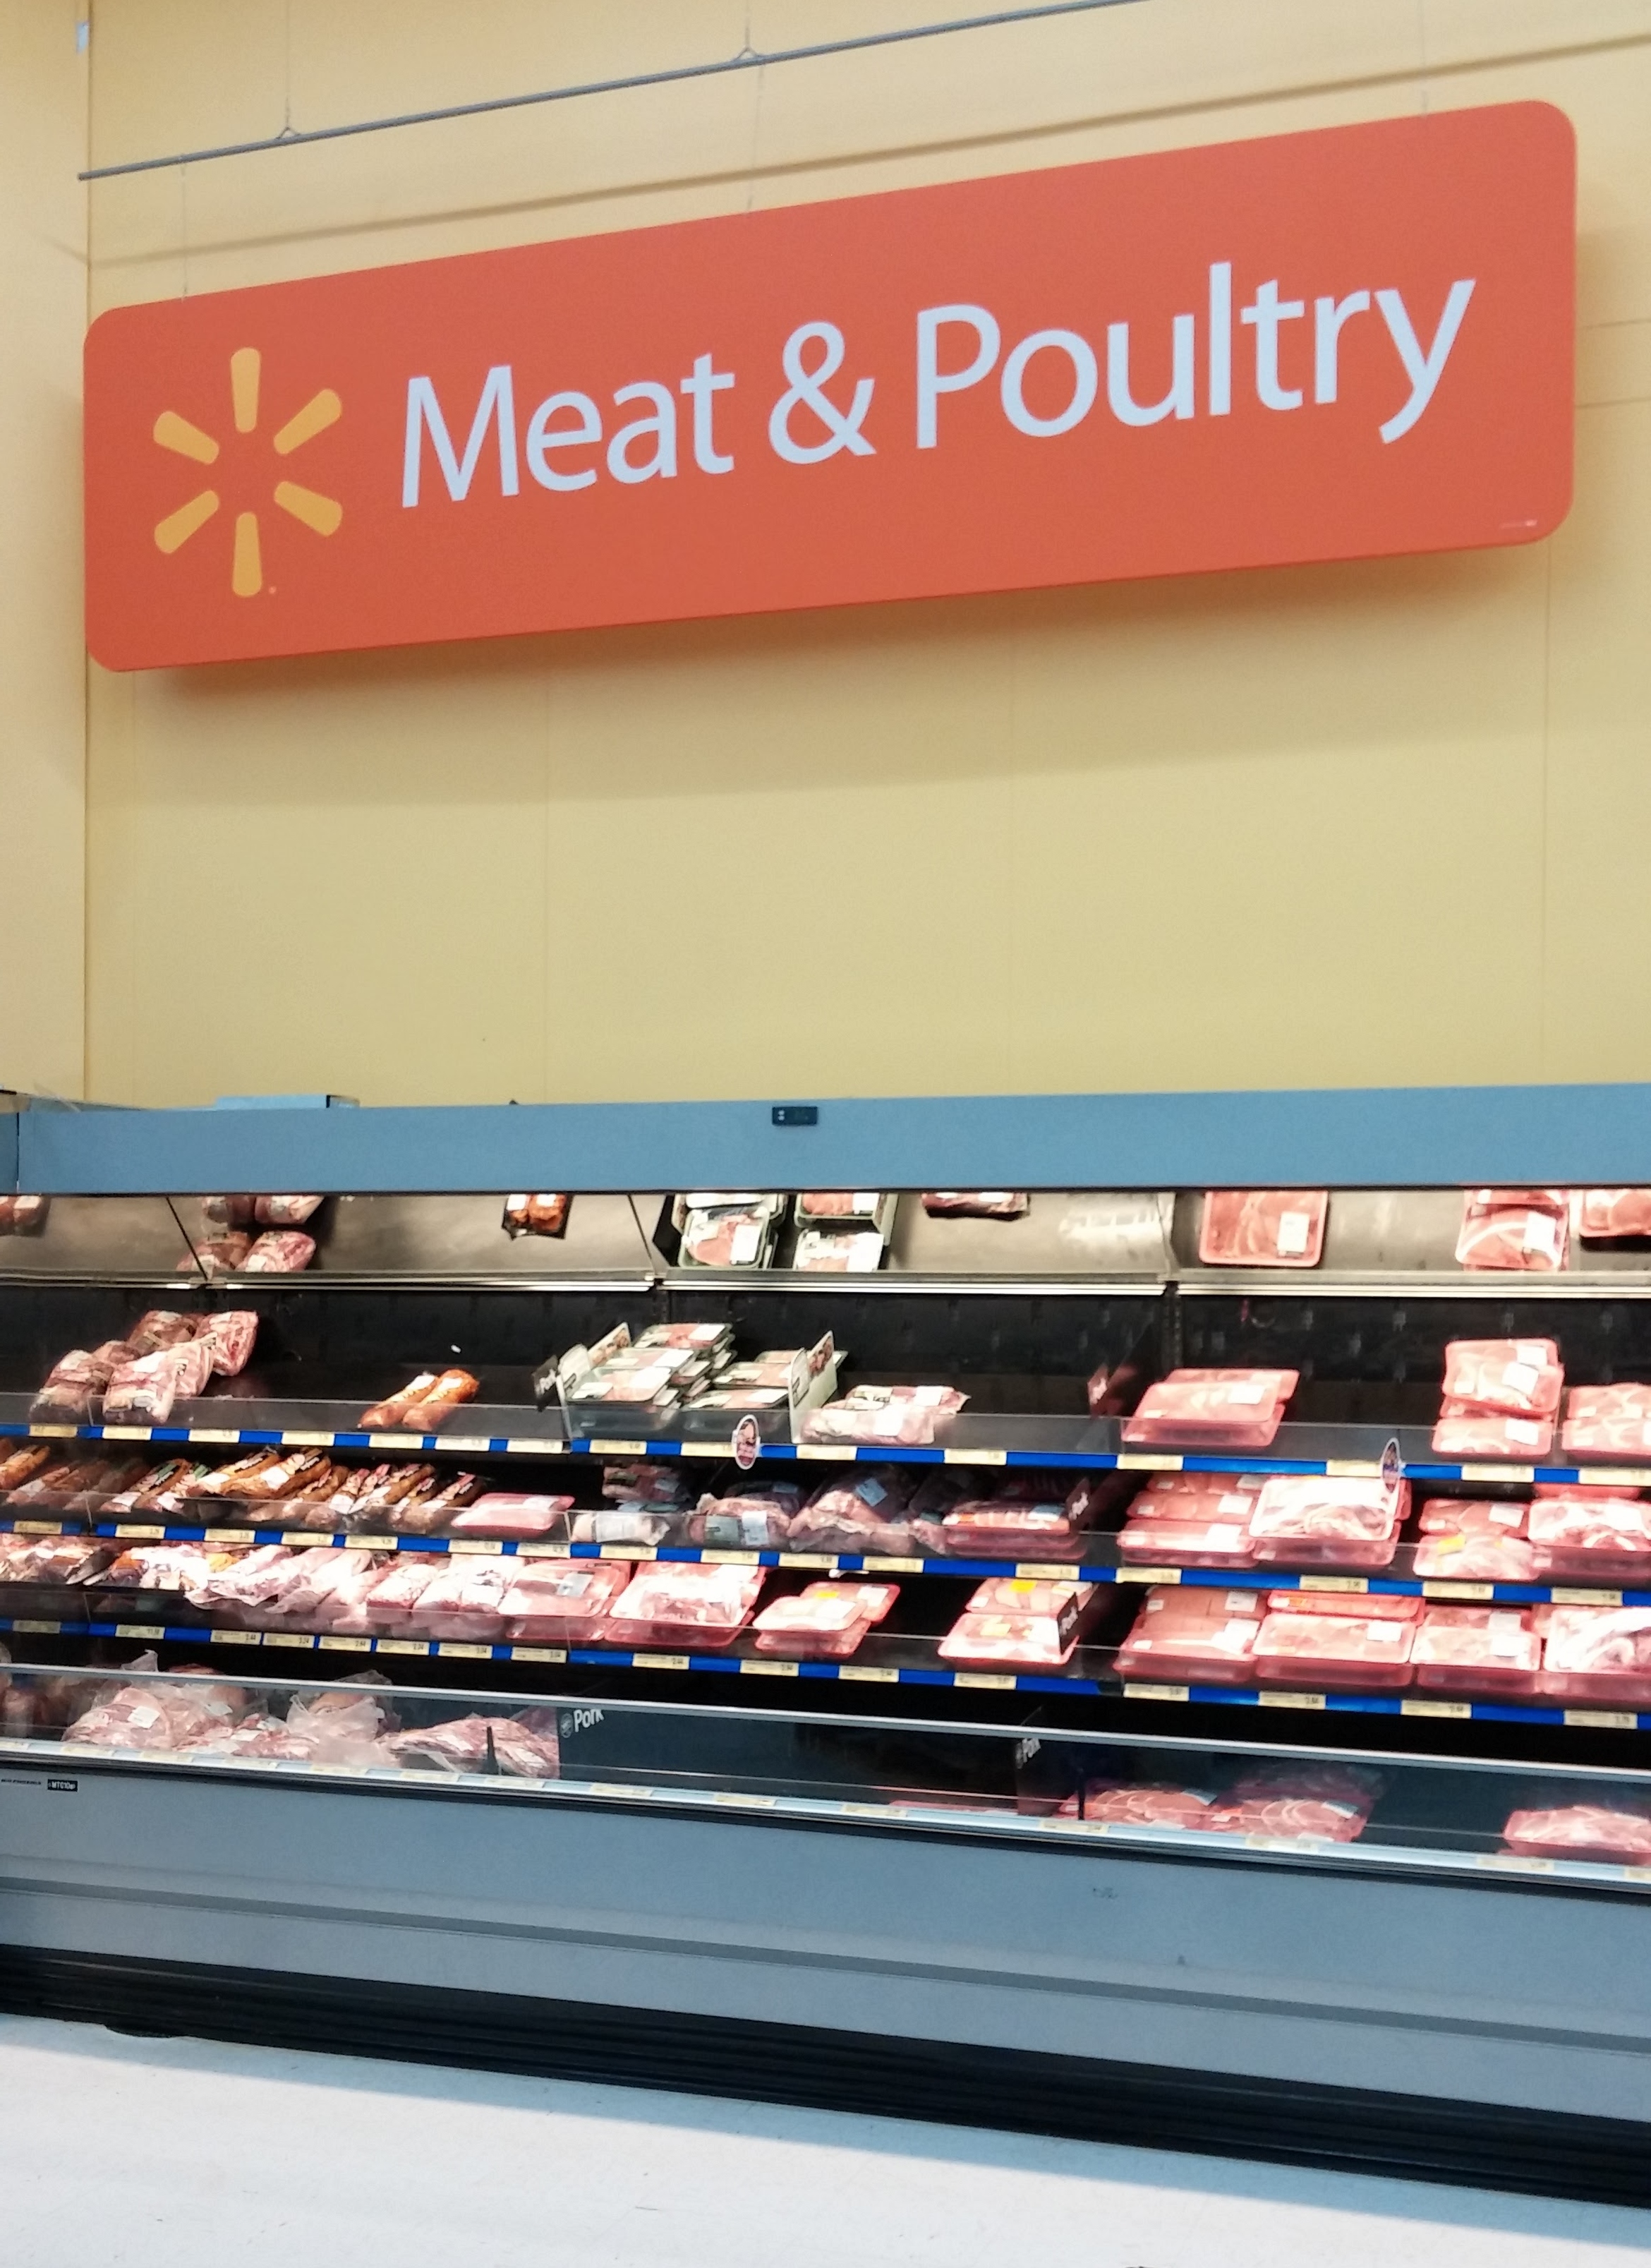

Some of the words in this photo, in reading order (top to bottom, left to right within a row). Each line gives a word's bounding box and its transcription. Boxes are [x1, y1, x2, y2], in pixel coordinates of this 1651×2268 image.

[401, 352, 734, 508] Meat
[768, 321, 877, 464] &
[917, 261, 1476, 450] Poultry
